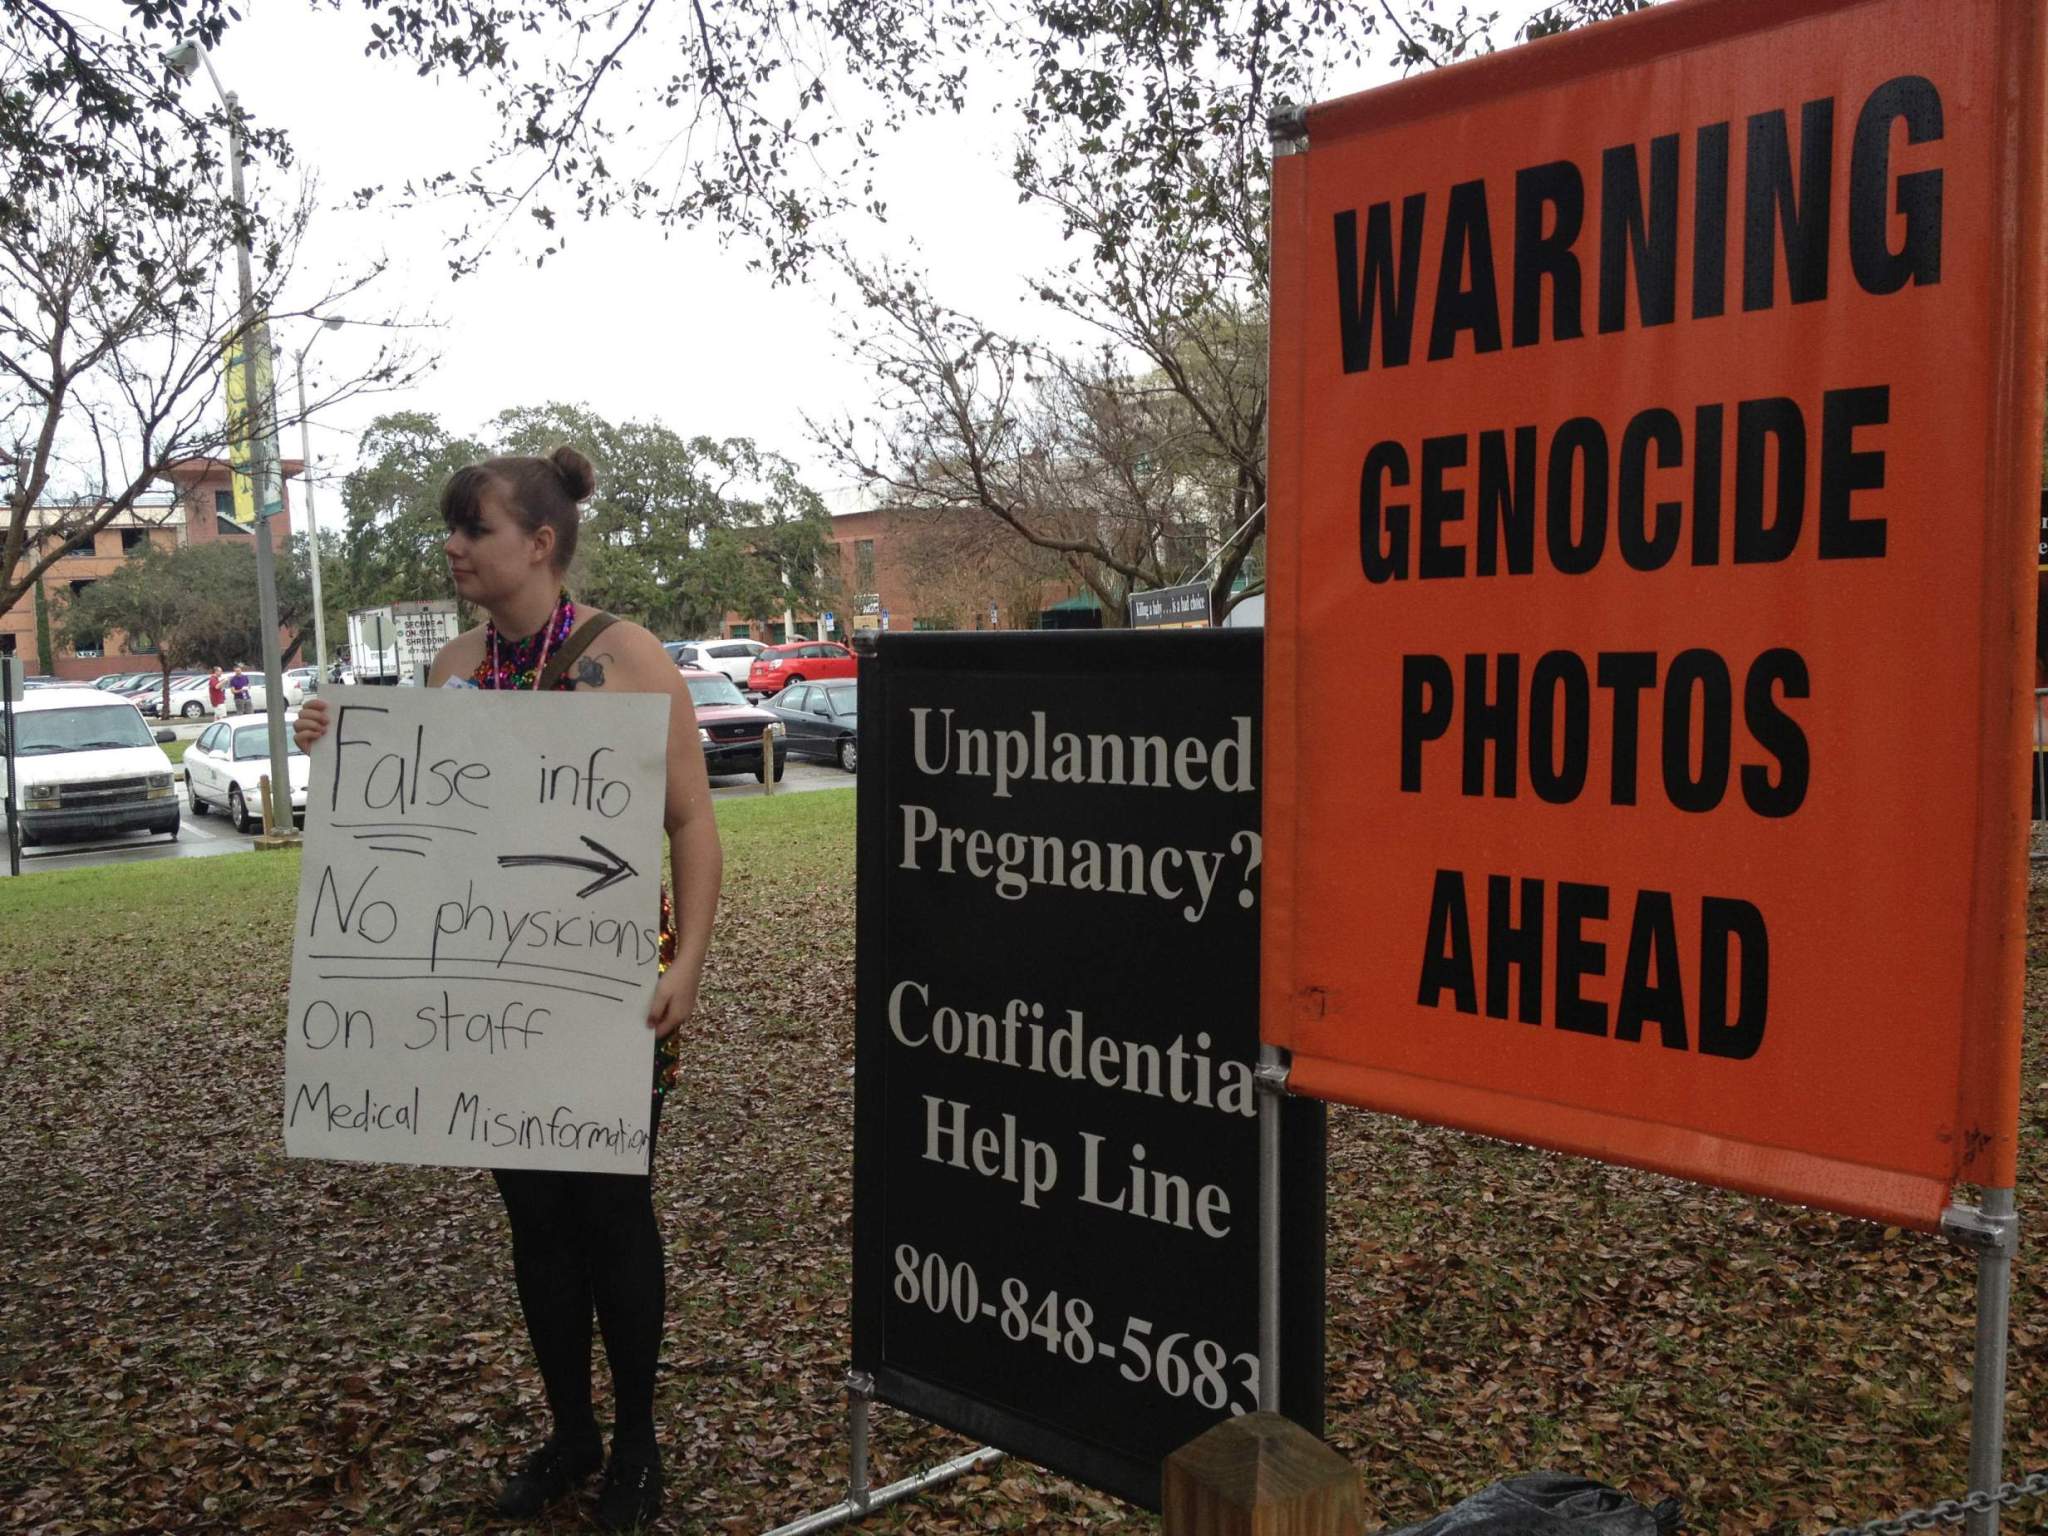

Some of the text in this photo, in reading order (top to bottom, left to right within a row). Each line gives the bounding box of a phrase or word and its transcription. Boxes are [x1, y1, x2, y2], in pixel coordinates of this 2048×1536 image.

[1333, 75, 1944, 374] WARNING
[1359, 384, 1890, 584] GENOCIDE
[332, 705, 632, 818] False info
[909, 708, 1256, 798] Unplanned
[1400, 648, 1810, 818] PHOTOS
[310, 865, 398, 944] No
[899, 804, 1262, 923] Pregnancy?
[1416, 868, 1769, 1060] AHEAD
[289, 1082, 651, 1157] Medical Misinformation
[888, 980, 1258, 1118] Confidentia
[921, 1094, 1231, 1239] Help Line
[893, 1243, 1261, 1416] 800-848-5683
